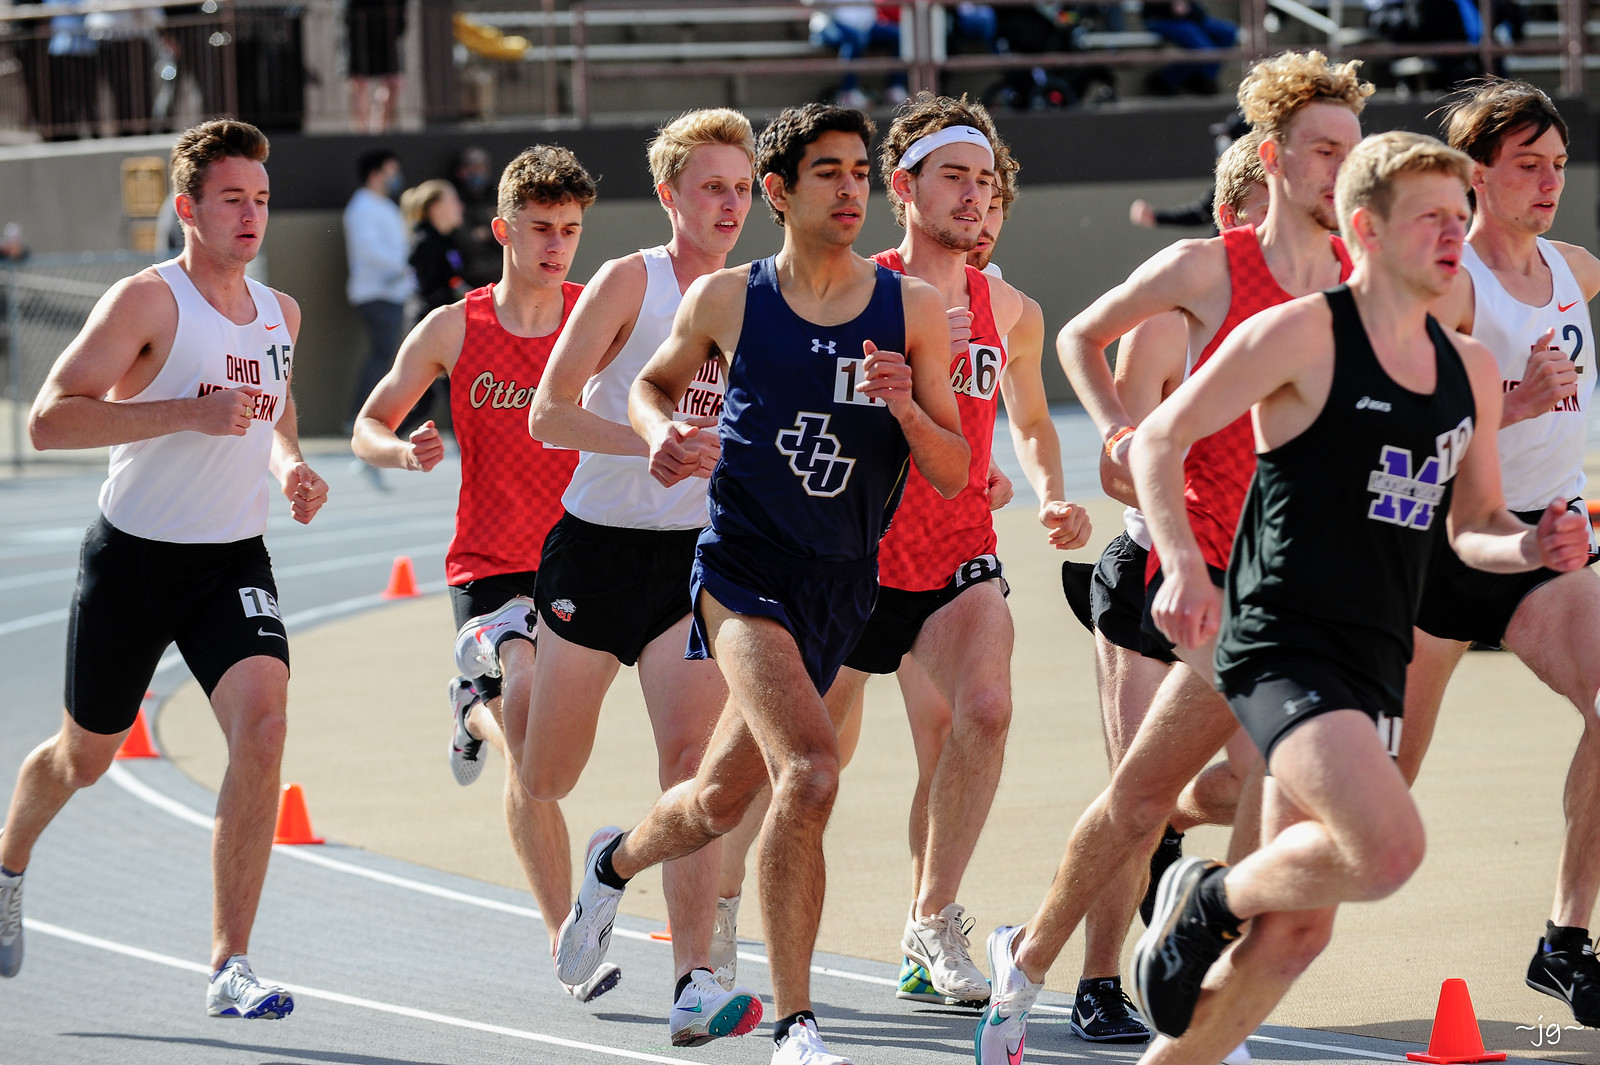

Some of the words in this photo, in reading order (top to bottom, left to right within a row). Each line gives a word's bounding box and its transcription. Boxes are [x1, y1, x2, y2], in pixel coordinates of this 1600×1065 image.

[226, 354, 261, 385] OHIO
[266, 344, 291, 381] 15
[975, 348, 997, 396] 6
[775, 411, 857, 498] JCU
